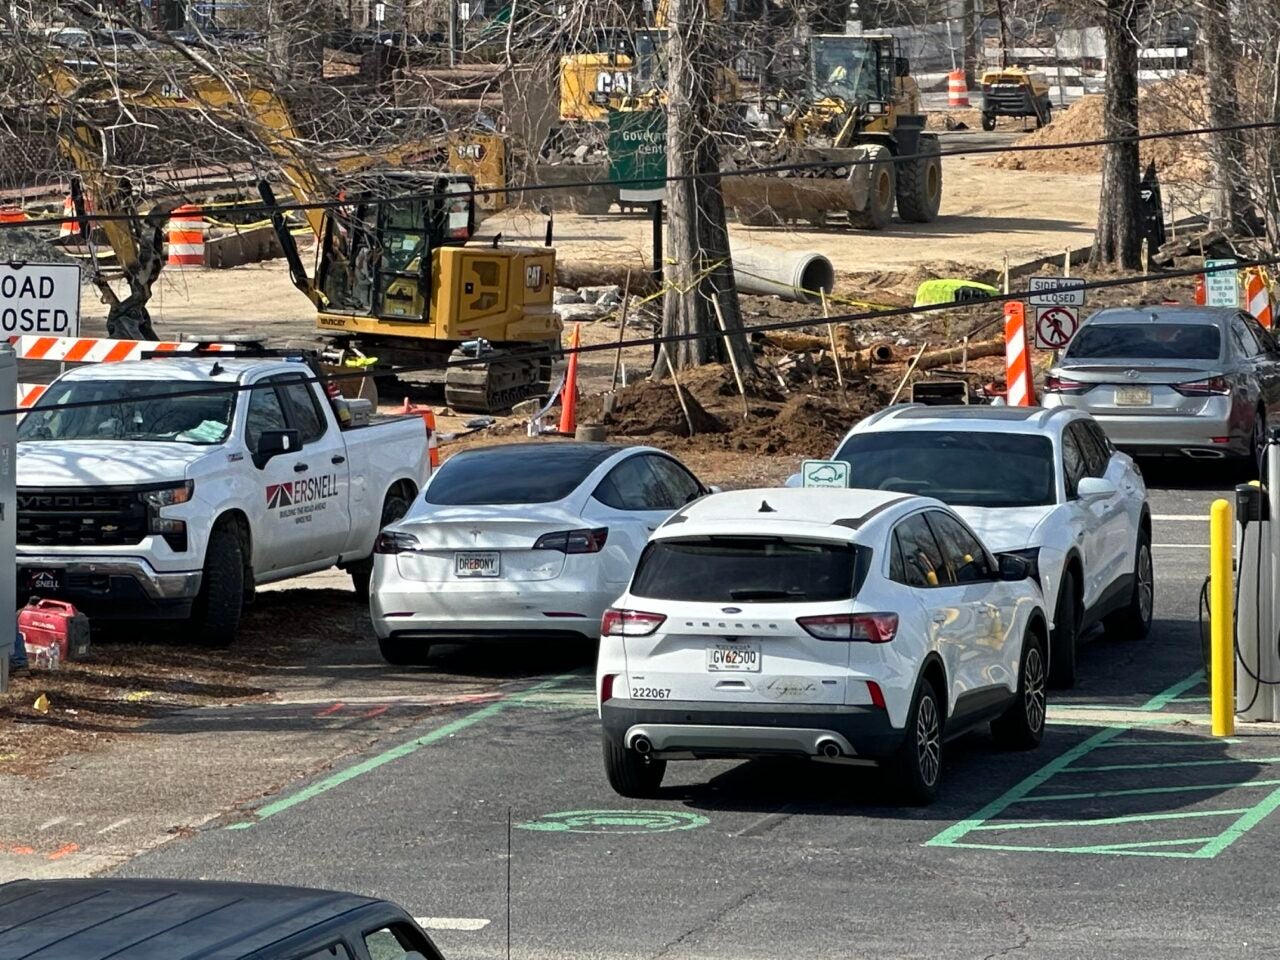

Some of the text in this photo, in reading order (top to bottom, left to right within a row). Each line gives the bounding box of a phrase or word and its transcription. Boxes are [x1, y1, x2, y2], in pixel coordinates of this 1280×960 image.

[638, 143, 668, 154] Cente
[527, 266, 541, 287] CAT
[1040, 293, 1076, 303] CLOSED
[294, 474, 338, 505] ERSNELL
[632, 688, 671, 699] 222067
